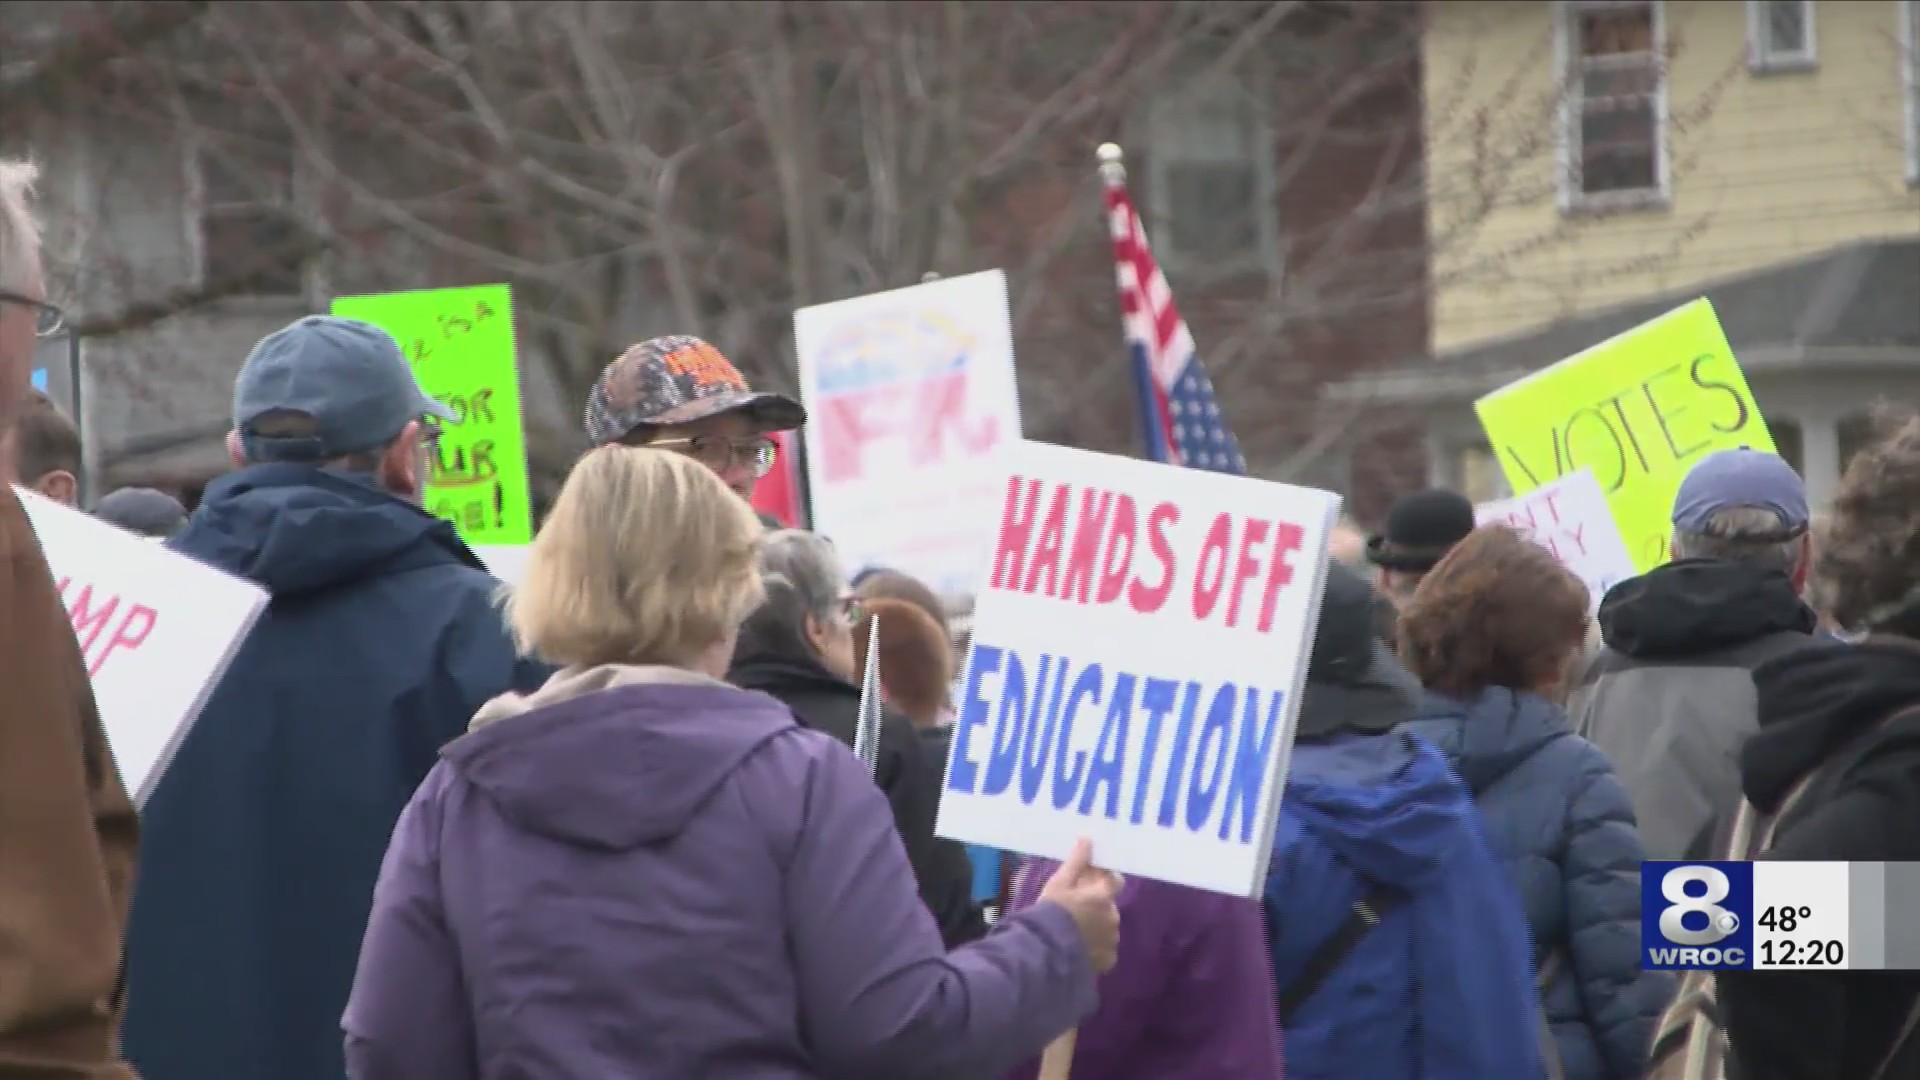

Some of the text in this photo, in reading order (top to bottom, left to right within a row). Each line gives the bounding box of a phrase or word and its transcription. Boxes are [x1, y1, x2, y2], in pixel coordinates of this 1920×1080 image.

[430, 439, 497, 478] UR
[1506, 351, 1749, 494] VOTES
[990, 474, 1306, 633] HANDS OFF
[56, 577, 157, 678] MP
[948, 644, 1283, 844] EDUCATION
